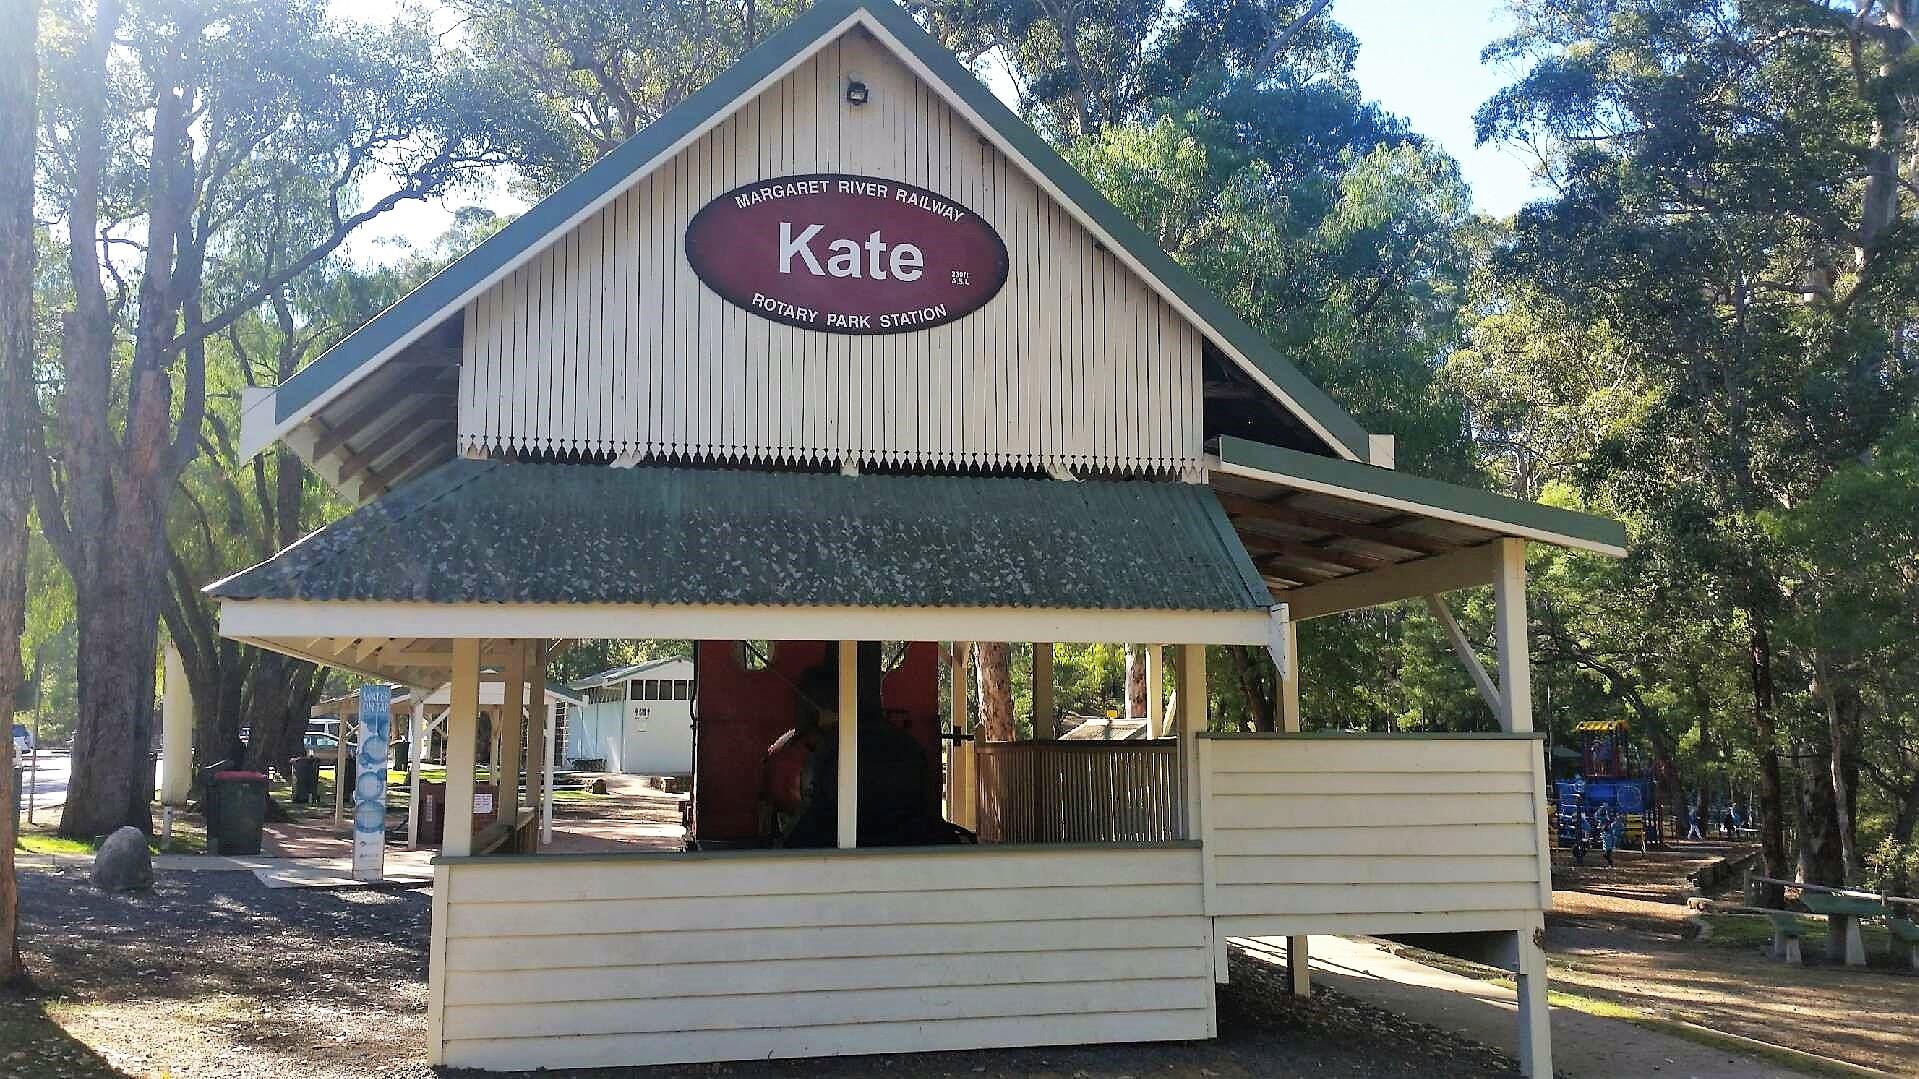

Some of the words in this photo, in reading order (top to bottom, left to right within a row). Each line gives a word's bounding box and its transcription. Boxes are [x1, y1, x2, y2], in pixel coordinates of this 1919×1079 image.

[736, 181, 829, 208] MARGARET
[838, 181, 888, 198] RIVER
[896, 188, 964, 222] RAILWAY
[778, 222, 924, 282] Kate
[752, 293, 818, 323] ROTARY
[826, 313, 871, 328] PARK
[879, 303, 948, 328] STATION
